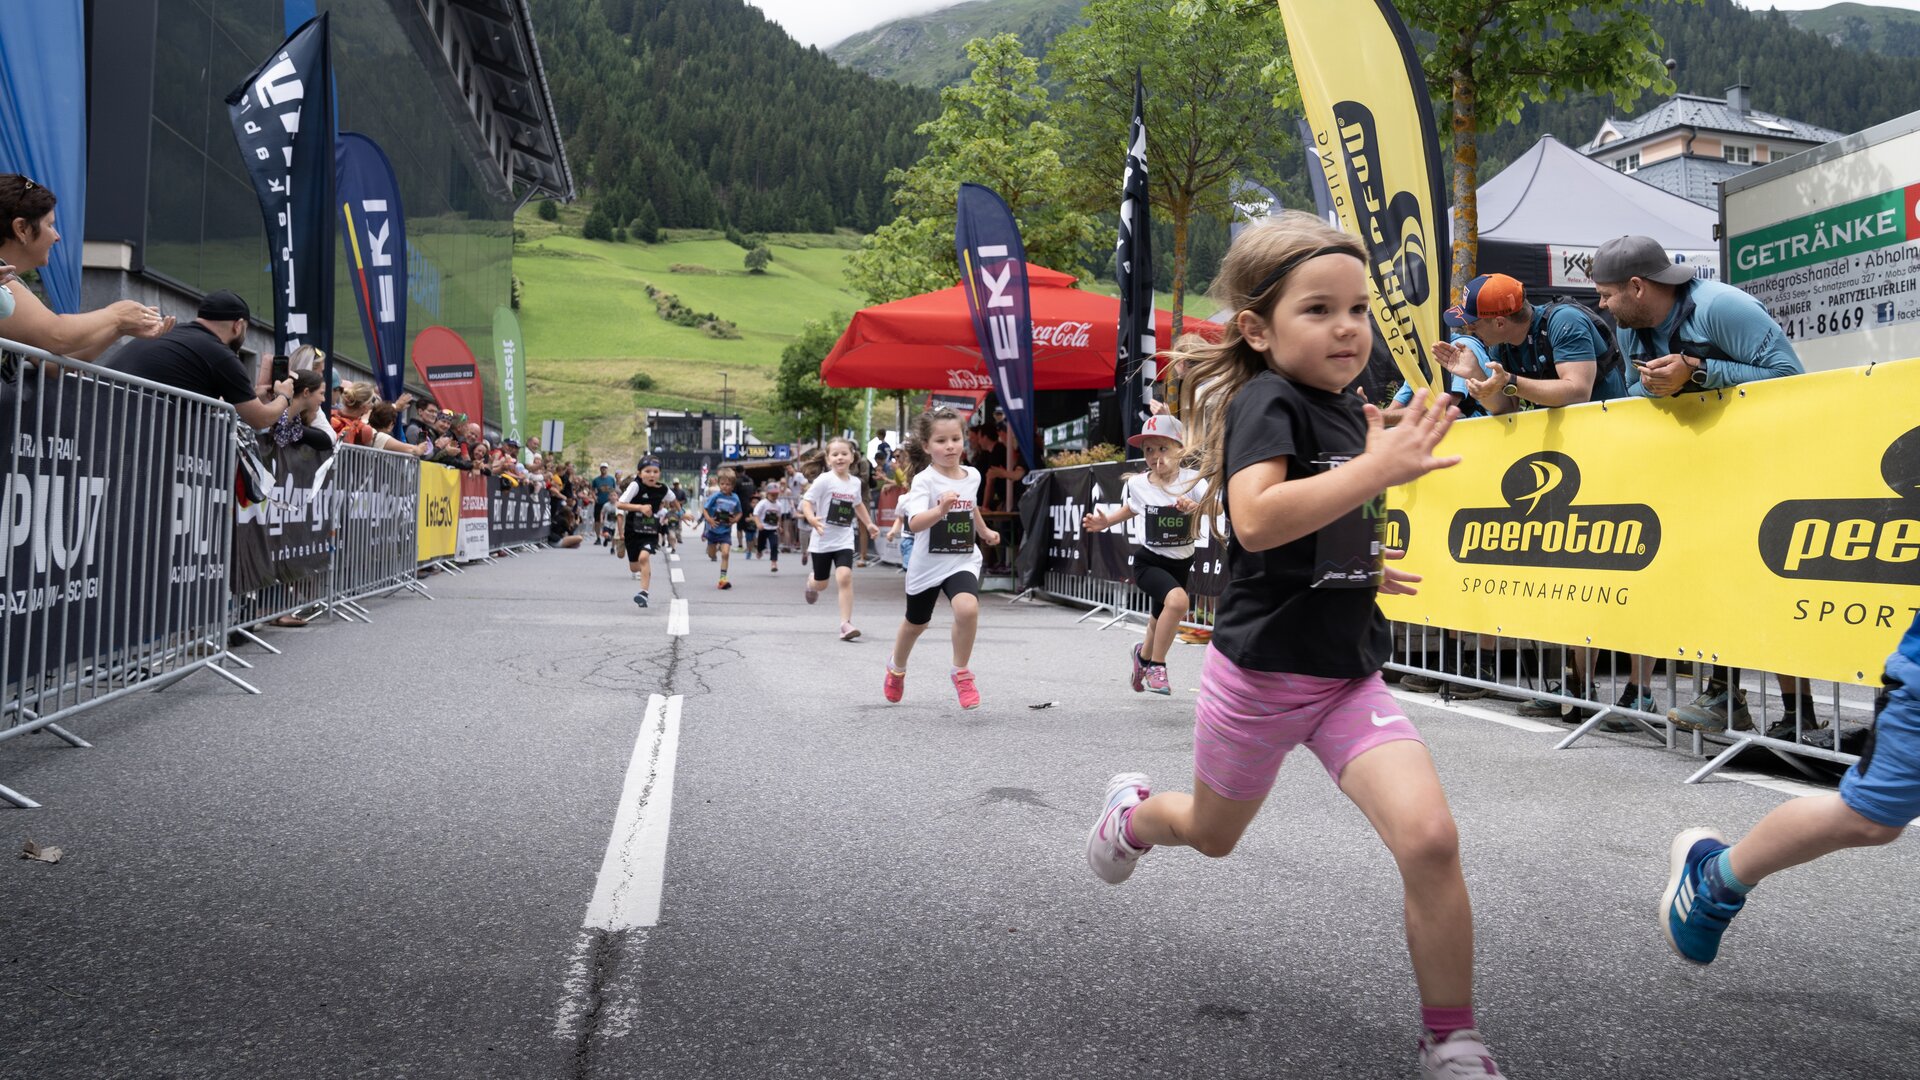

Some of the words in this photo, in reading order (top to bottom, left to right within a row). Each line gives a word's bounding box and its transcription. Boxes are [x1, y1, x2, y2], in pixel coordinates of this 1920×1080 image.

[1736, 207, 1897, 271] GETRÄNKE
[1741, 258, 1850, 297] tränkegrosshandel
[1865, 245, 1920, 269] Abholm
[1862, 273, 1875, 284] 327
[1767, 300, 1812, 319] HL-HÄNGER
[1828, 277, 1917, 307] PARTYZELT-VERLEIH
[1780, 306, 1864, 340] 41-8669
[947, 521, 971, 534] K85
[1158, 516, 1184, 528] K66
[1459, 513, 1644, 559] peeroton
[1461, 577, 1629, 606] SPORTNAHRUNG
